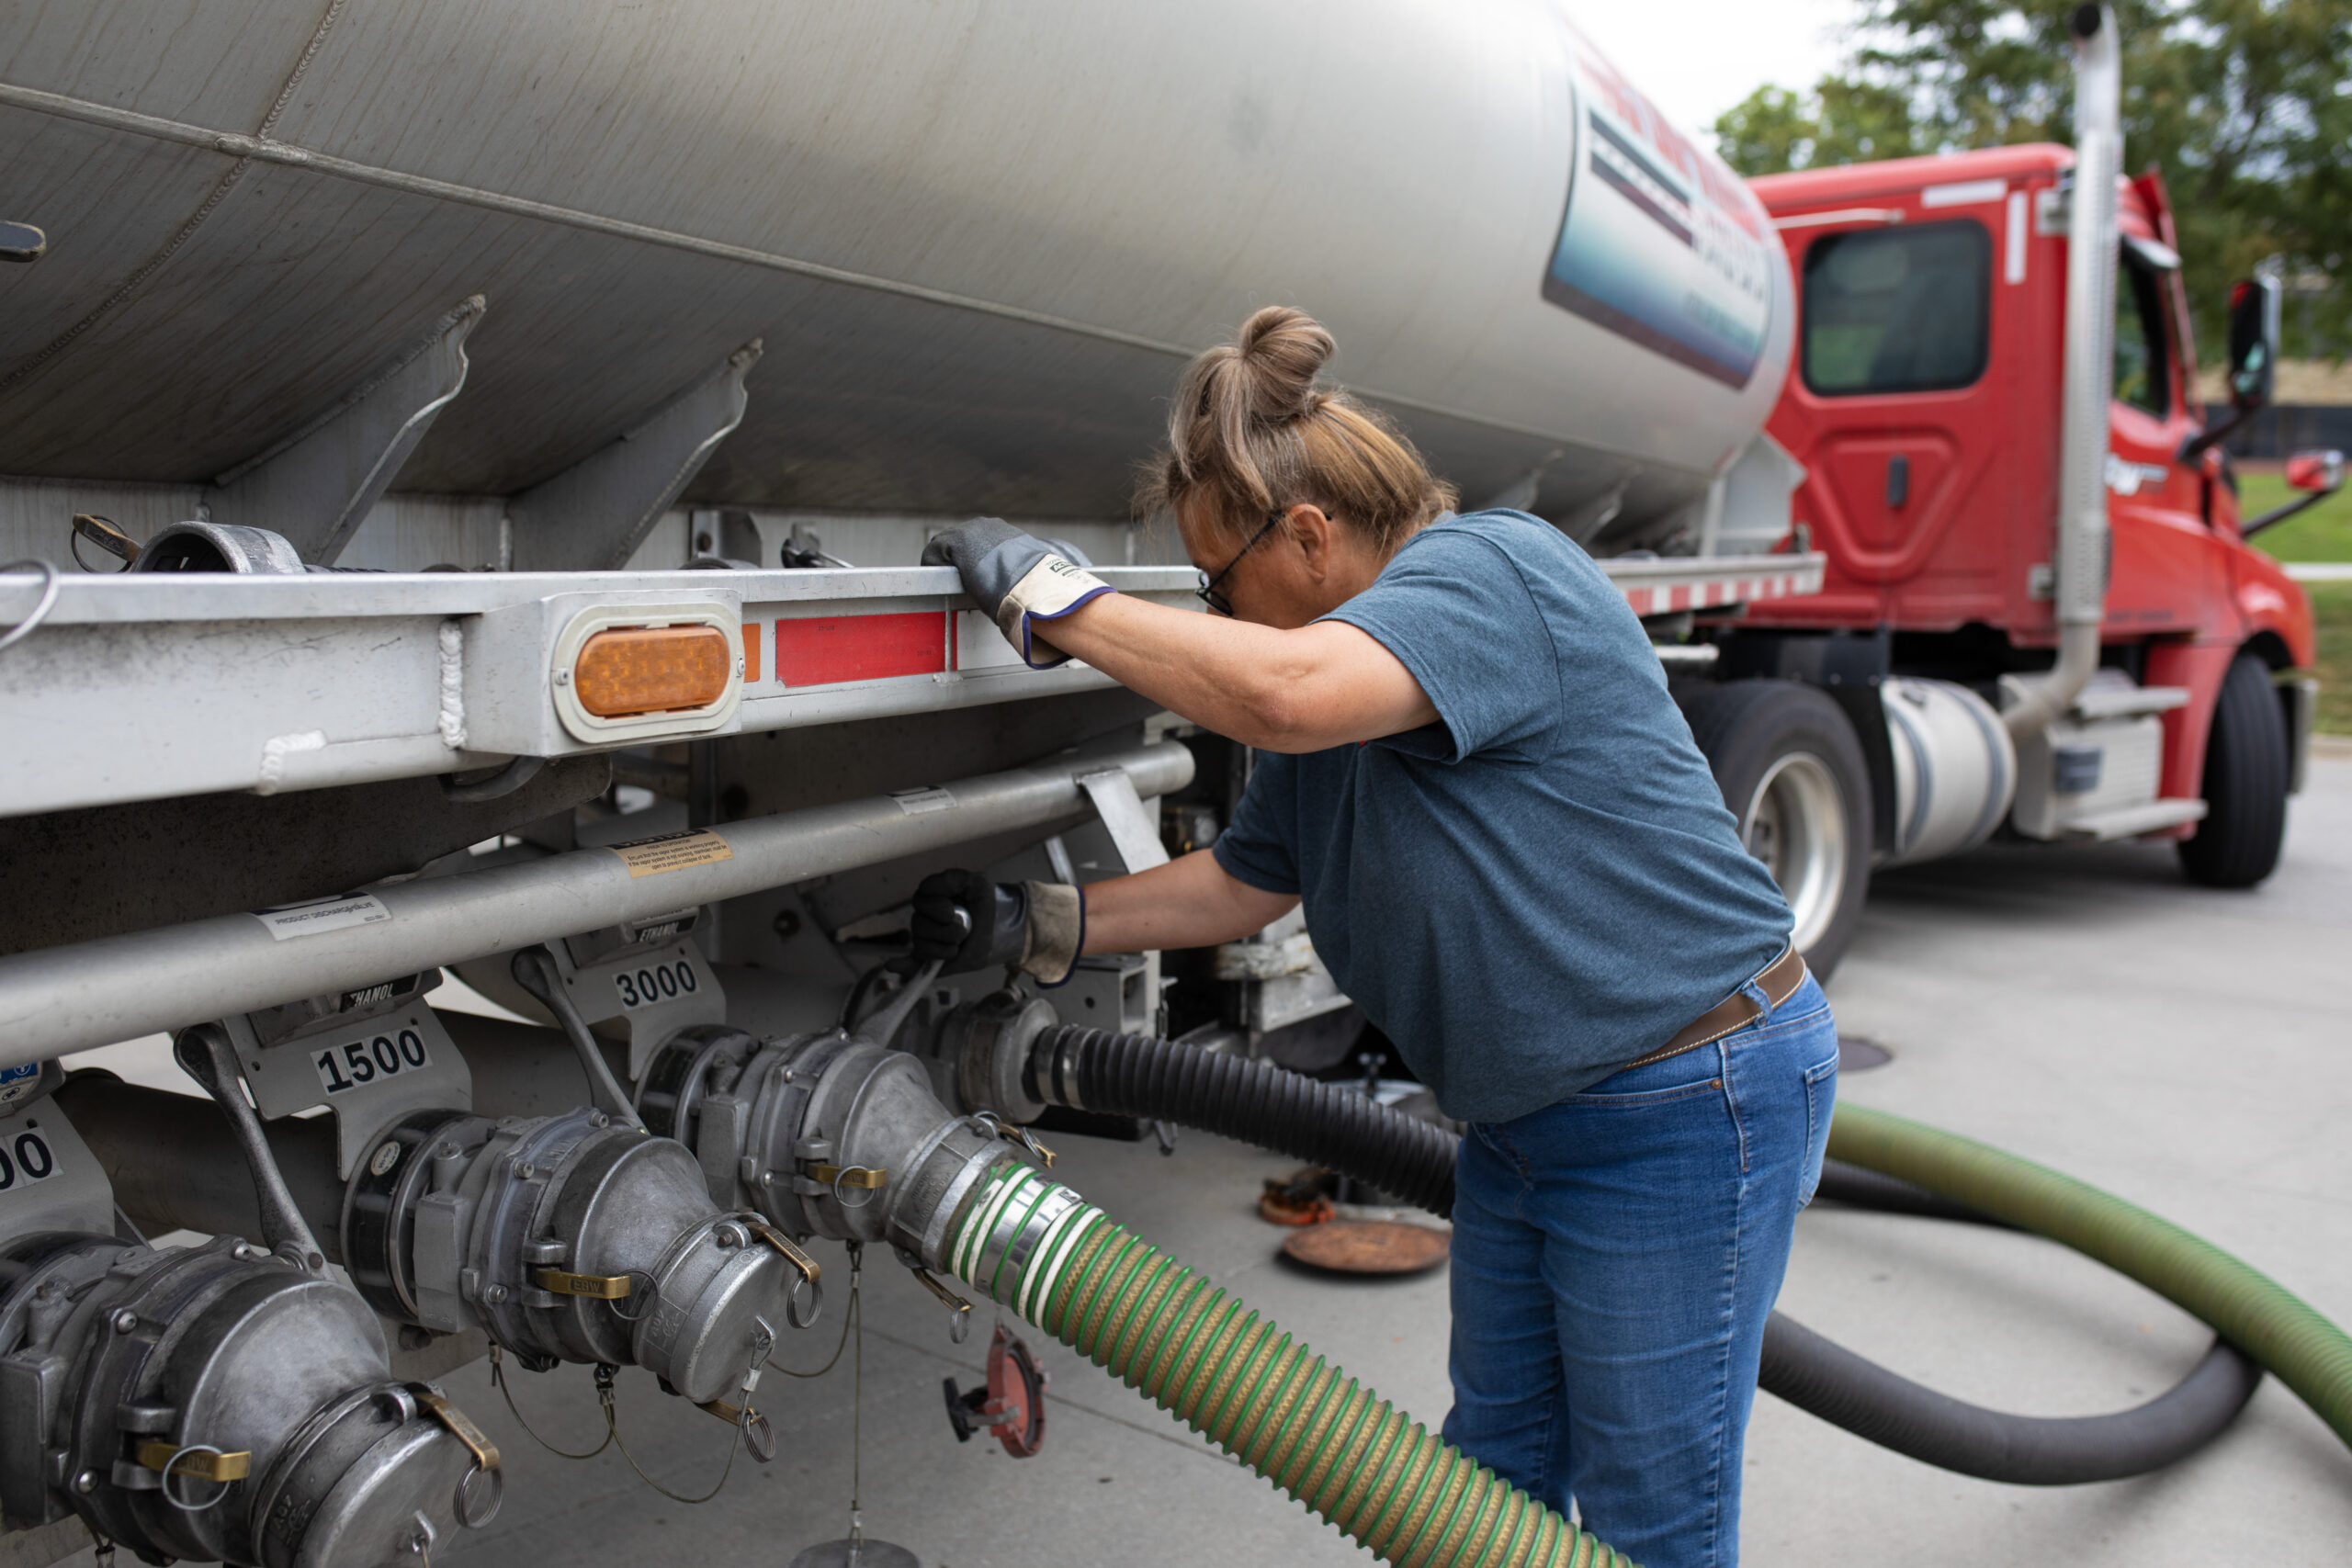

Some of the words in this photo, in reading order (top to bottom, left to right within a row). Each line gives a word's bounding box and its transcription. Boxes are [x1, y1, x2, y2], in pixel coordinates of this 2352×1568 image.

[275, 913, 311, 925] PRODUCT
[349, 982, 393, 1008] THANOL
[616, 961, 696, 1008] 3000
[317, 1030, 425, 1094] 1500
